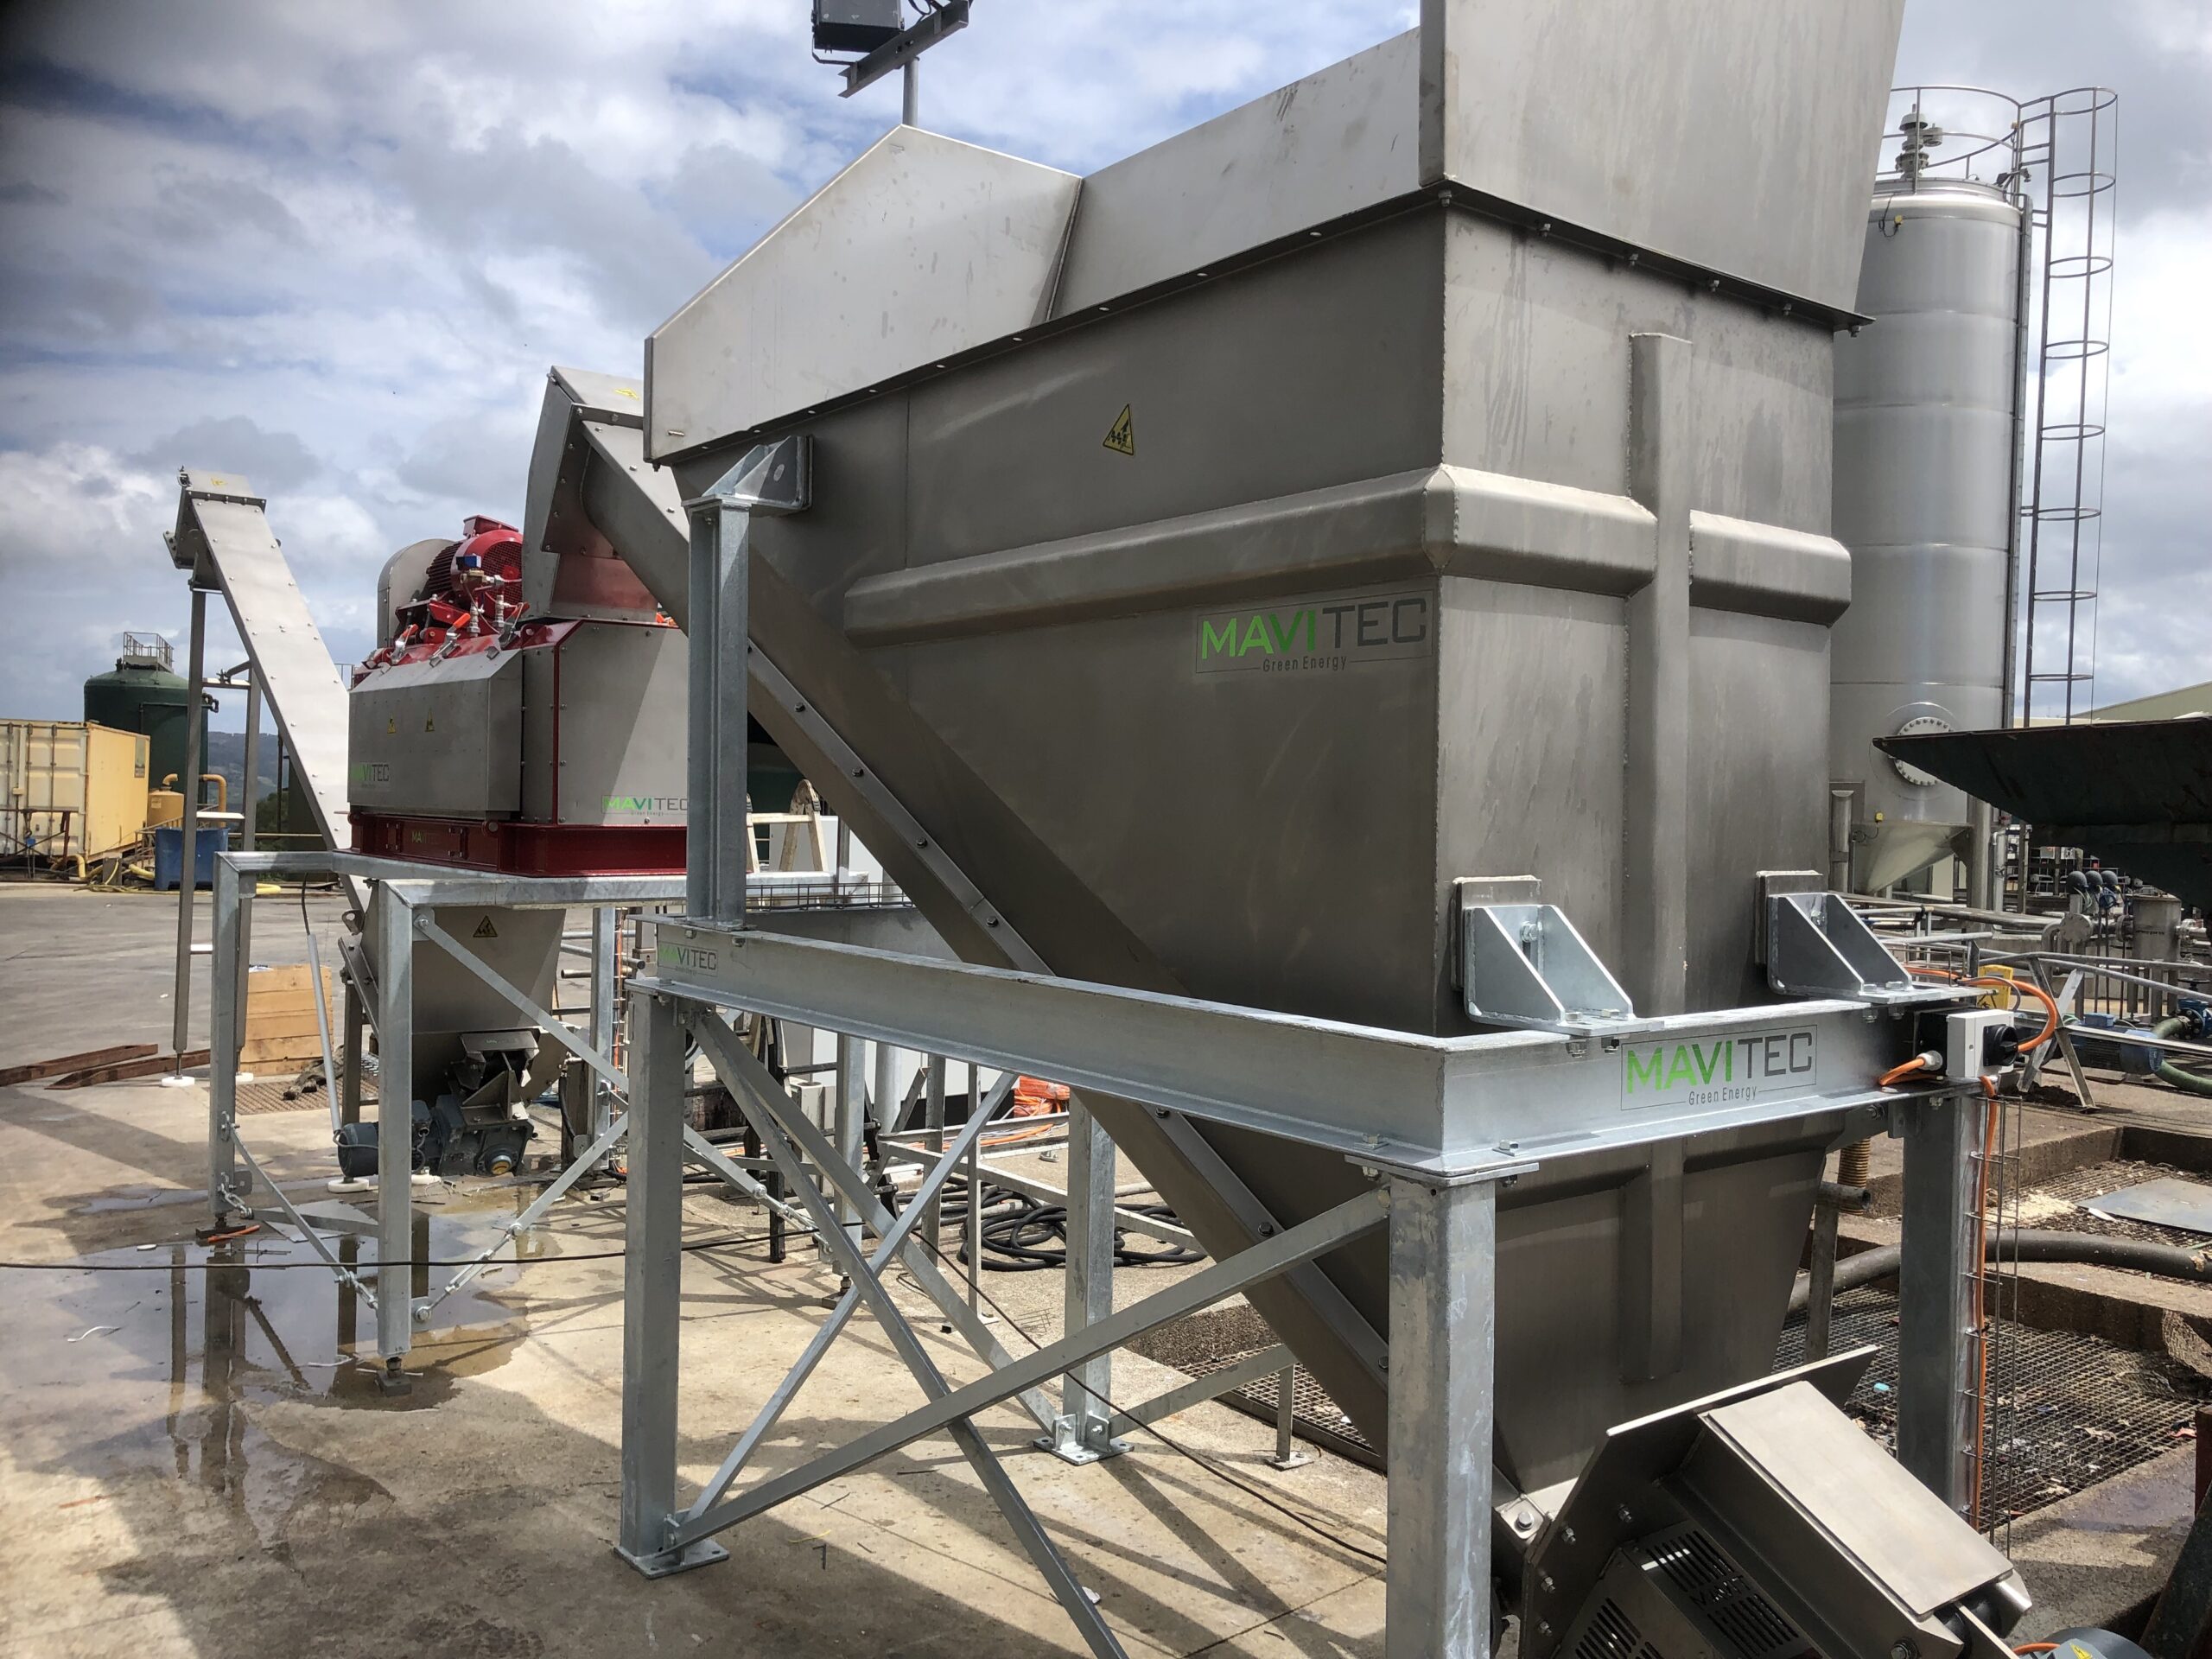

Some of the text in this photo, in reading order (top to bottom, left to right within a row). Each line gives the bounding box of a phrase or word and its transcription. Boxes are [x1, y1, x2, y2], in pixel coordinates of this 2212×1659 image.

[1201, 598, 1427, 659] MAVITEC
[1262, 654, 1347, 672] Green Energy
[1626, 1032, 1813, 1094] MAVITEC
[1688, 1086, 1758, 1106] Green Energy
